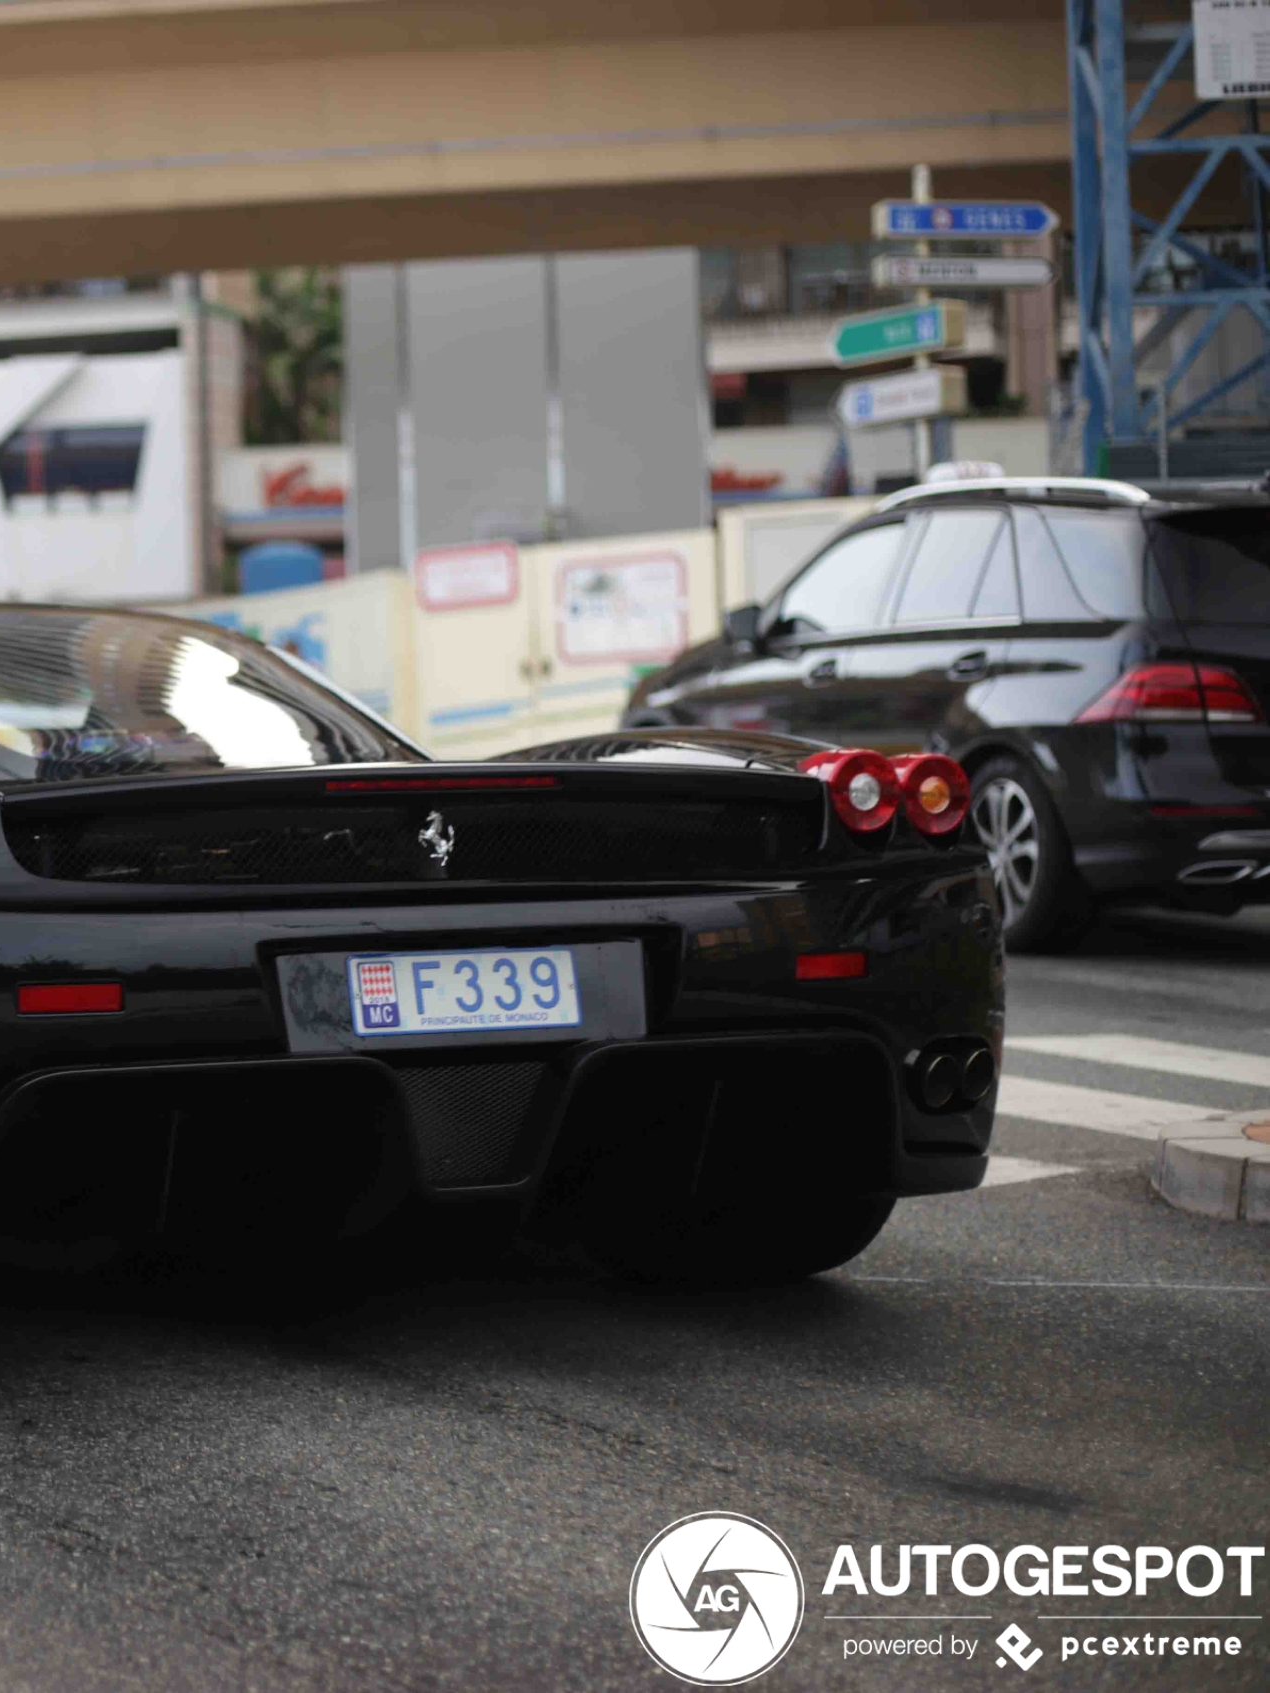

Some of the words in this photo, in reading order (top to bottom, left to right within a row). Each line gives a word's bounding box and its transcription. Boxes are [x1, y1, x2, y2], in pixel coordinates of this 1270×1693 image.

[411, 956, 561, 1015] F339
[369, 1006, 394, 1023] MC
[488, 1014, 502, 1024] DE
[505, 1012, 549, 1023] MONACO
